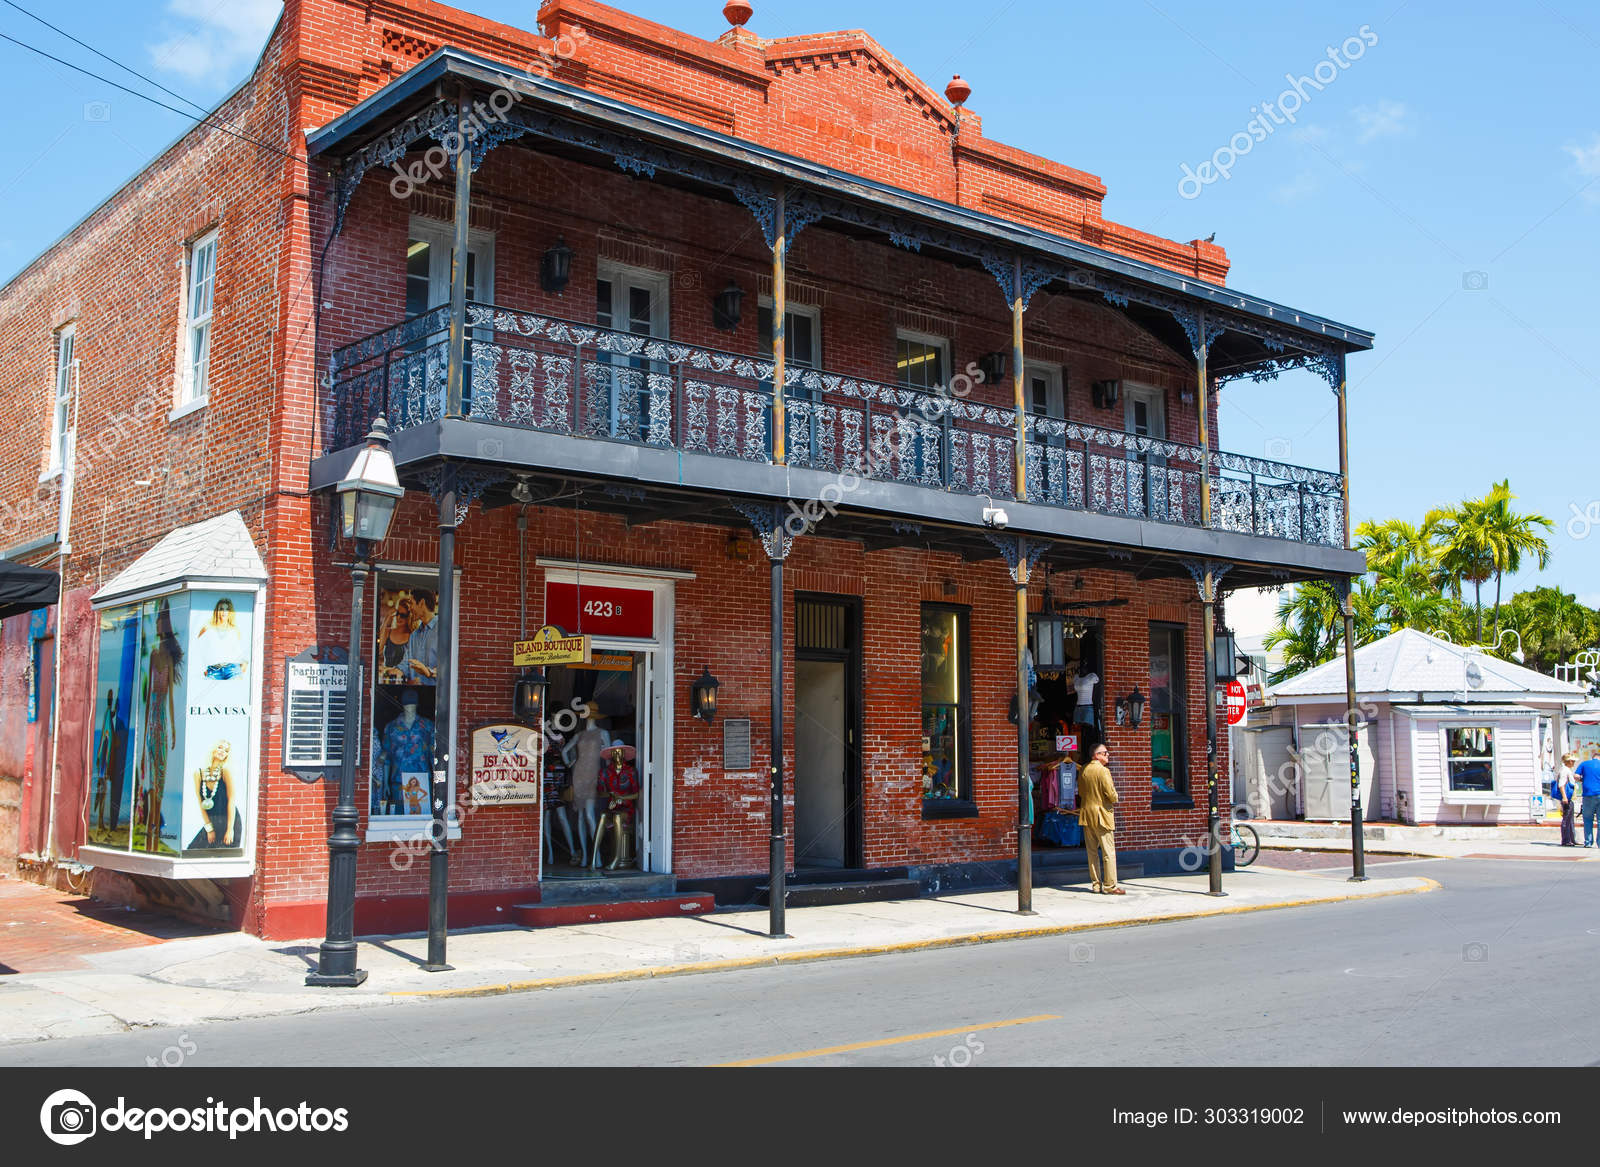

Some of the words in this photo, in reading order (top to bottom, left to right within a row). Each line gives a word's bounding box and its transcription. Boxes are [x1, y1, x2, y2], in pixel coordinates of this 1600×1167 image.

[583, 600, 613, 617] 423
[515, 641, 541, 655] ISLAND
[543, 638, 582, 652] BOUTIQUE
[1231, 685, 1241, 694] NOT
[225, 706, 246, 715] USA
[1227, 706, 1240, 715] TER
[483, 755, 528, 768] ISLAND
[474, 769, 535, 783] BOUTIQUE
